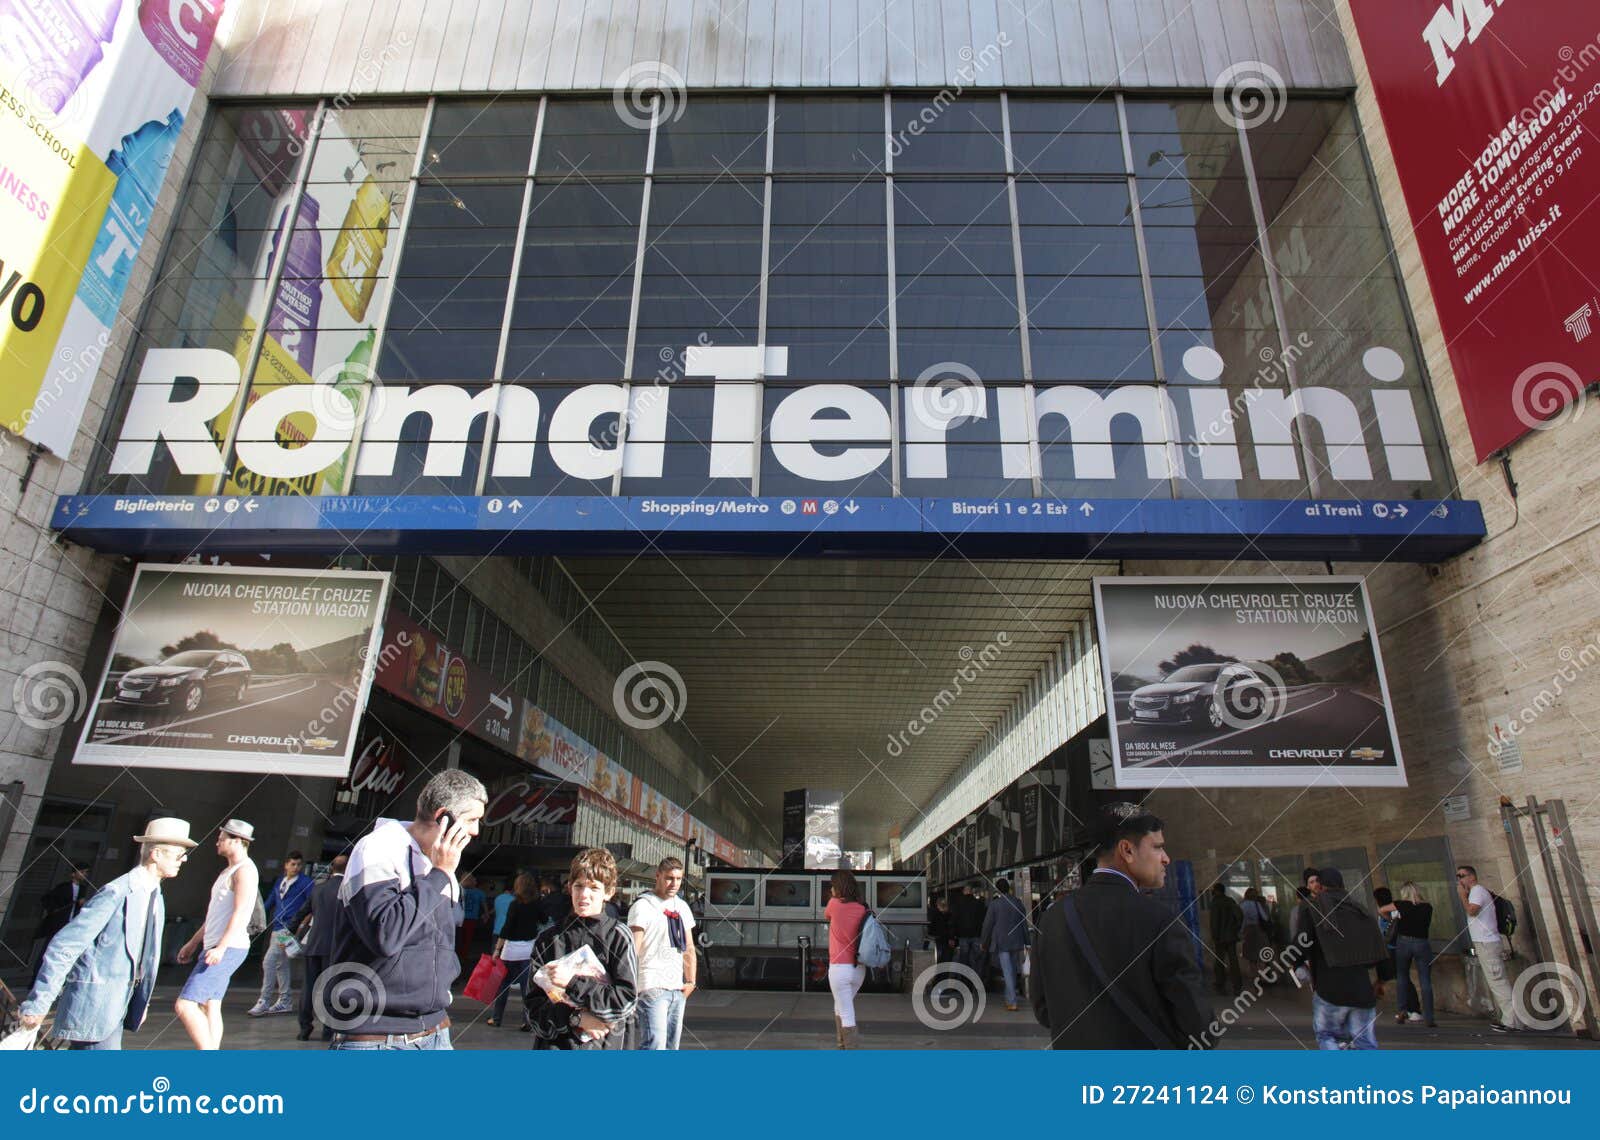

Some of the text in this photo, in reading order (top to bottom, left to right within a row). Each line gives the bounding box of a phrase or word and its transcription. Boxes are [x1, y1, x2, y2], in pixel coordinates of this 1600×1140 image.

[27, 115, 76, 169] SCHOOL
[1437, 115, 1524, 218] MORE TODAY.
[1443, 86, 1573, 235] MORE TOMORROW.
[1449, 224, 1471, 251] Check
[1471, 208, 1486, 227] out
[1485, 194, 1499, 212] the
[1500, 175, 1518, 197] new
[1518, 132, 1557, 178] program
[1452, 125, 1583, 265] MBA LUISS Open Evening Event
[128, 201, 146, 226] TV
[1456, 253, 1482, 278] Rome,
[1481, 216, 1513, 253] October
[1535, 185, 1543, 197] 6
[1544, 173, 1555, 189] to
[1555, 163, 1563, 176] 9
[1565, 146, 1583, 168] pm
[1464, 203, 1562, 304] www.mba.luiss.it
[114, 498, 195, 515] Biglietteria
[641, 499, 769, 517] Shopping/Metro
[952, 500, 1068, 515] Binari 1 e 2 Est
[1305, 503, 1362, 516] ai Treni
[183, 582, 373, 603] NUOVA CHEVROLET CRUZE
[1154, 593, 1356, 609] NUOVA CHEVROLET CRUZE
[251, 601, 369, 618] STATION WAGON
[1236, 609, 1359, 624] STATION WAGON
[491, 719, 502, 736] 30
[227, 734, 299, 746] CHEVROLET
[1150, 742, 1159, 750] AL
[1160, 741, 1176, 750] MESE
[1269, 749, 1344, 759] CHEVROLET
[484, 782, 576, 828] Ciao
